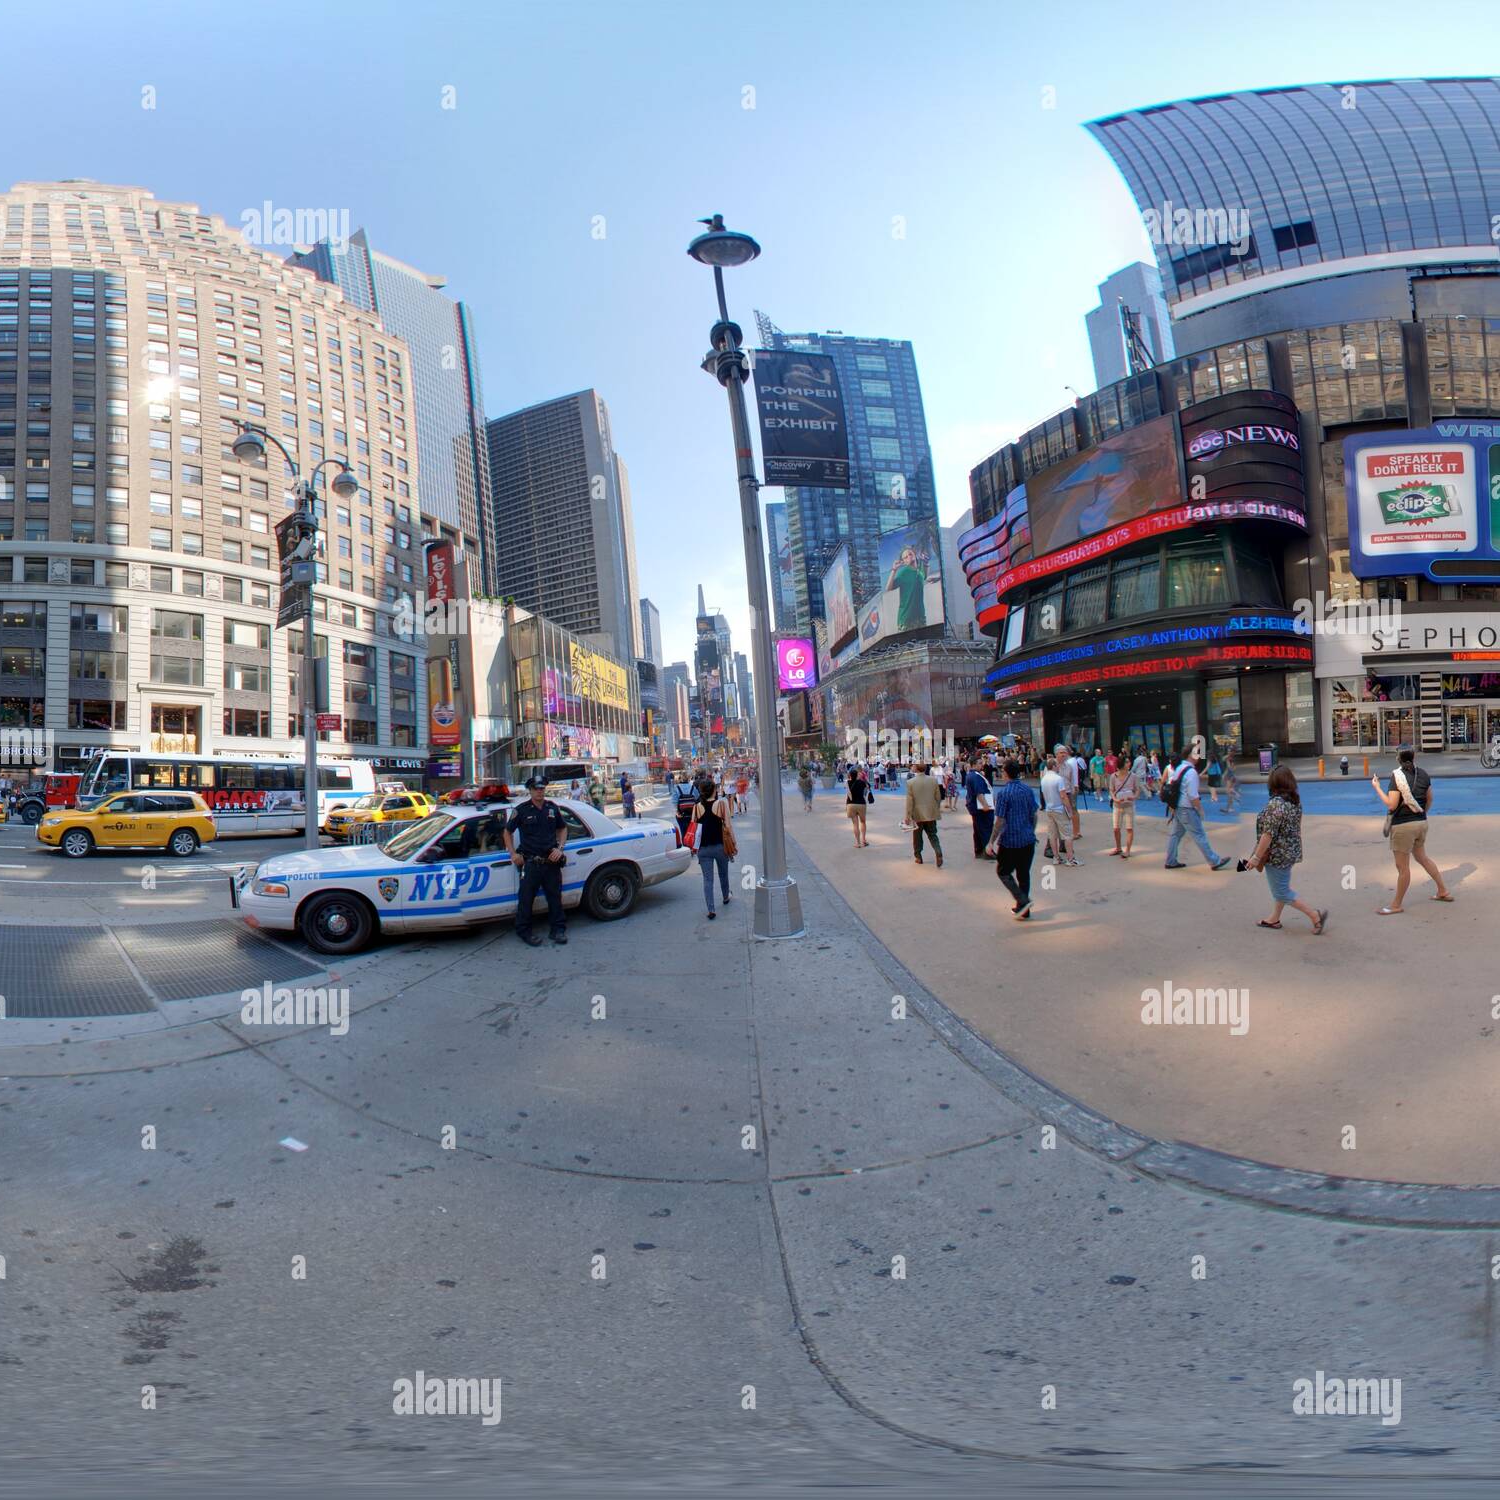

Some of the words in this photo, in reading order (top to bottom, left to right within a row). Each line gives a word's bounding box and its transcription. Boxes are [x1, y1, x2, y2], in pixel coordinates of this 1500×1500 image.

[760, 386, 837, 398] POMPEII
[762, 401, 800, 411] THE
[765, 418, 838, 431] EXHIBIT
[1189, 436, 1224, 454] abc
[1225, 426, 1299, 449] NEWS
[1389, 454, 1428, 465] SPEAK
[1432, 454, 1442, 463] IT
[1374, 464, 1410, 475] DON'T
[1413, 463, 1444, 473] REEK
[1447, 463, 1457, 472] IT
[1386, 496, 1441, 512] eclipse
[1107, 634, 1146, 653] CASEY
[1150, 625, 1221, 646] ANTHONY
[1372, 627, 1497, 651] SEPHO
[788, 669, 805, 680] LG
[1102, 659, 1162, 679] STEWART
[1442, 675, 1476, 692] NAIL
[287, 873, 319, 881] POLICE
[408, 866, 490, 902] NYPD
